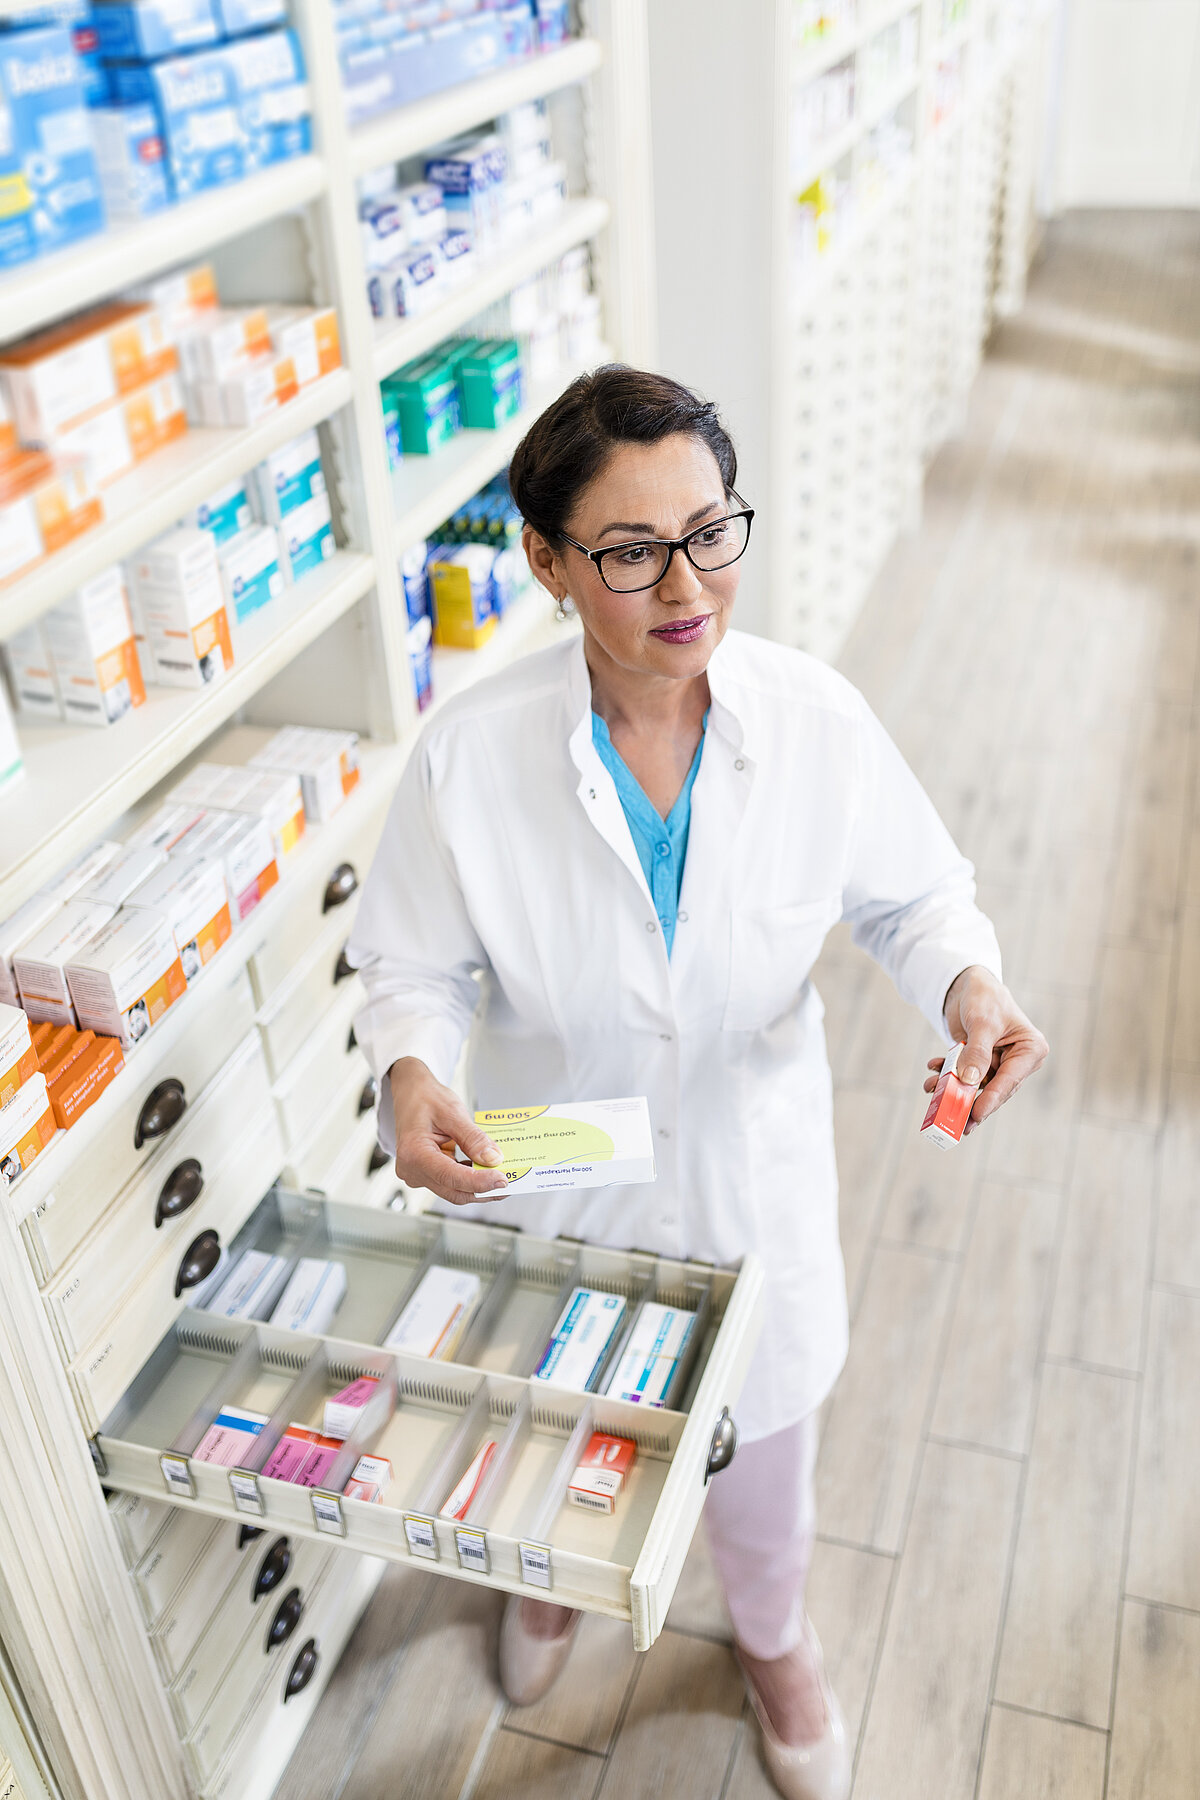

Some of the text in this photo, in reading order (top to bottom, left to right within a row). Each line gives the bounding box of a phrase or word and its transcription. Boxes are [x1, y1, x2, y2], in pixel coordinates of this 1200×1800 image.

[485, 1111, 531, 1121] 500 mg
[495, 1134, 541, 1143] Hartkapse
[506, 1171, 517, 1180] 50
[535, 1168, 571, 1176] Hartkapseln
